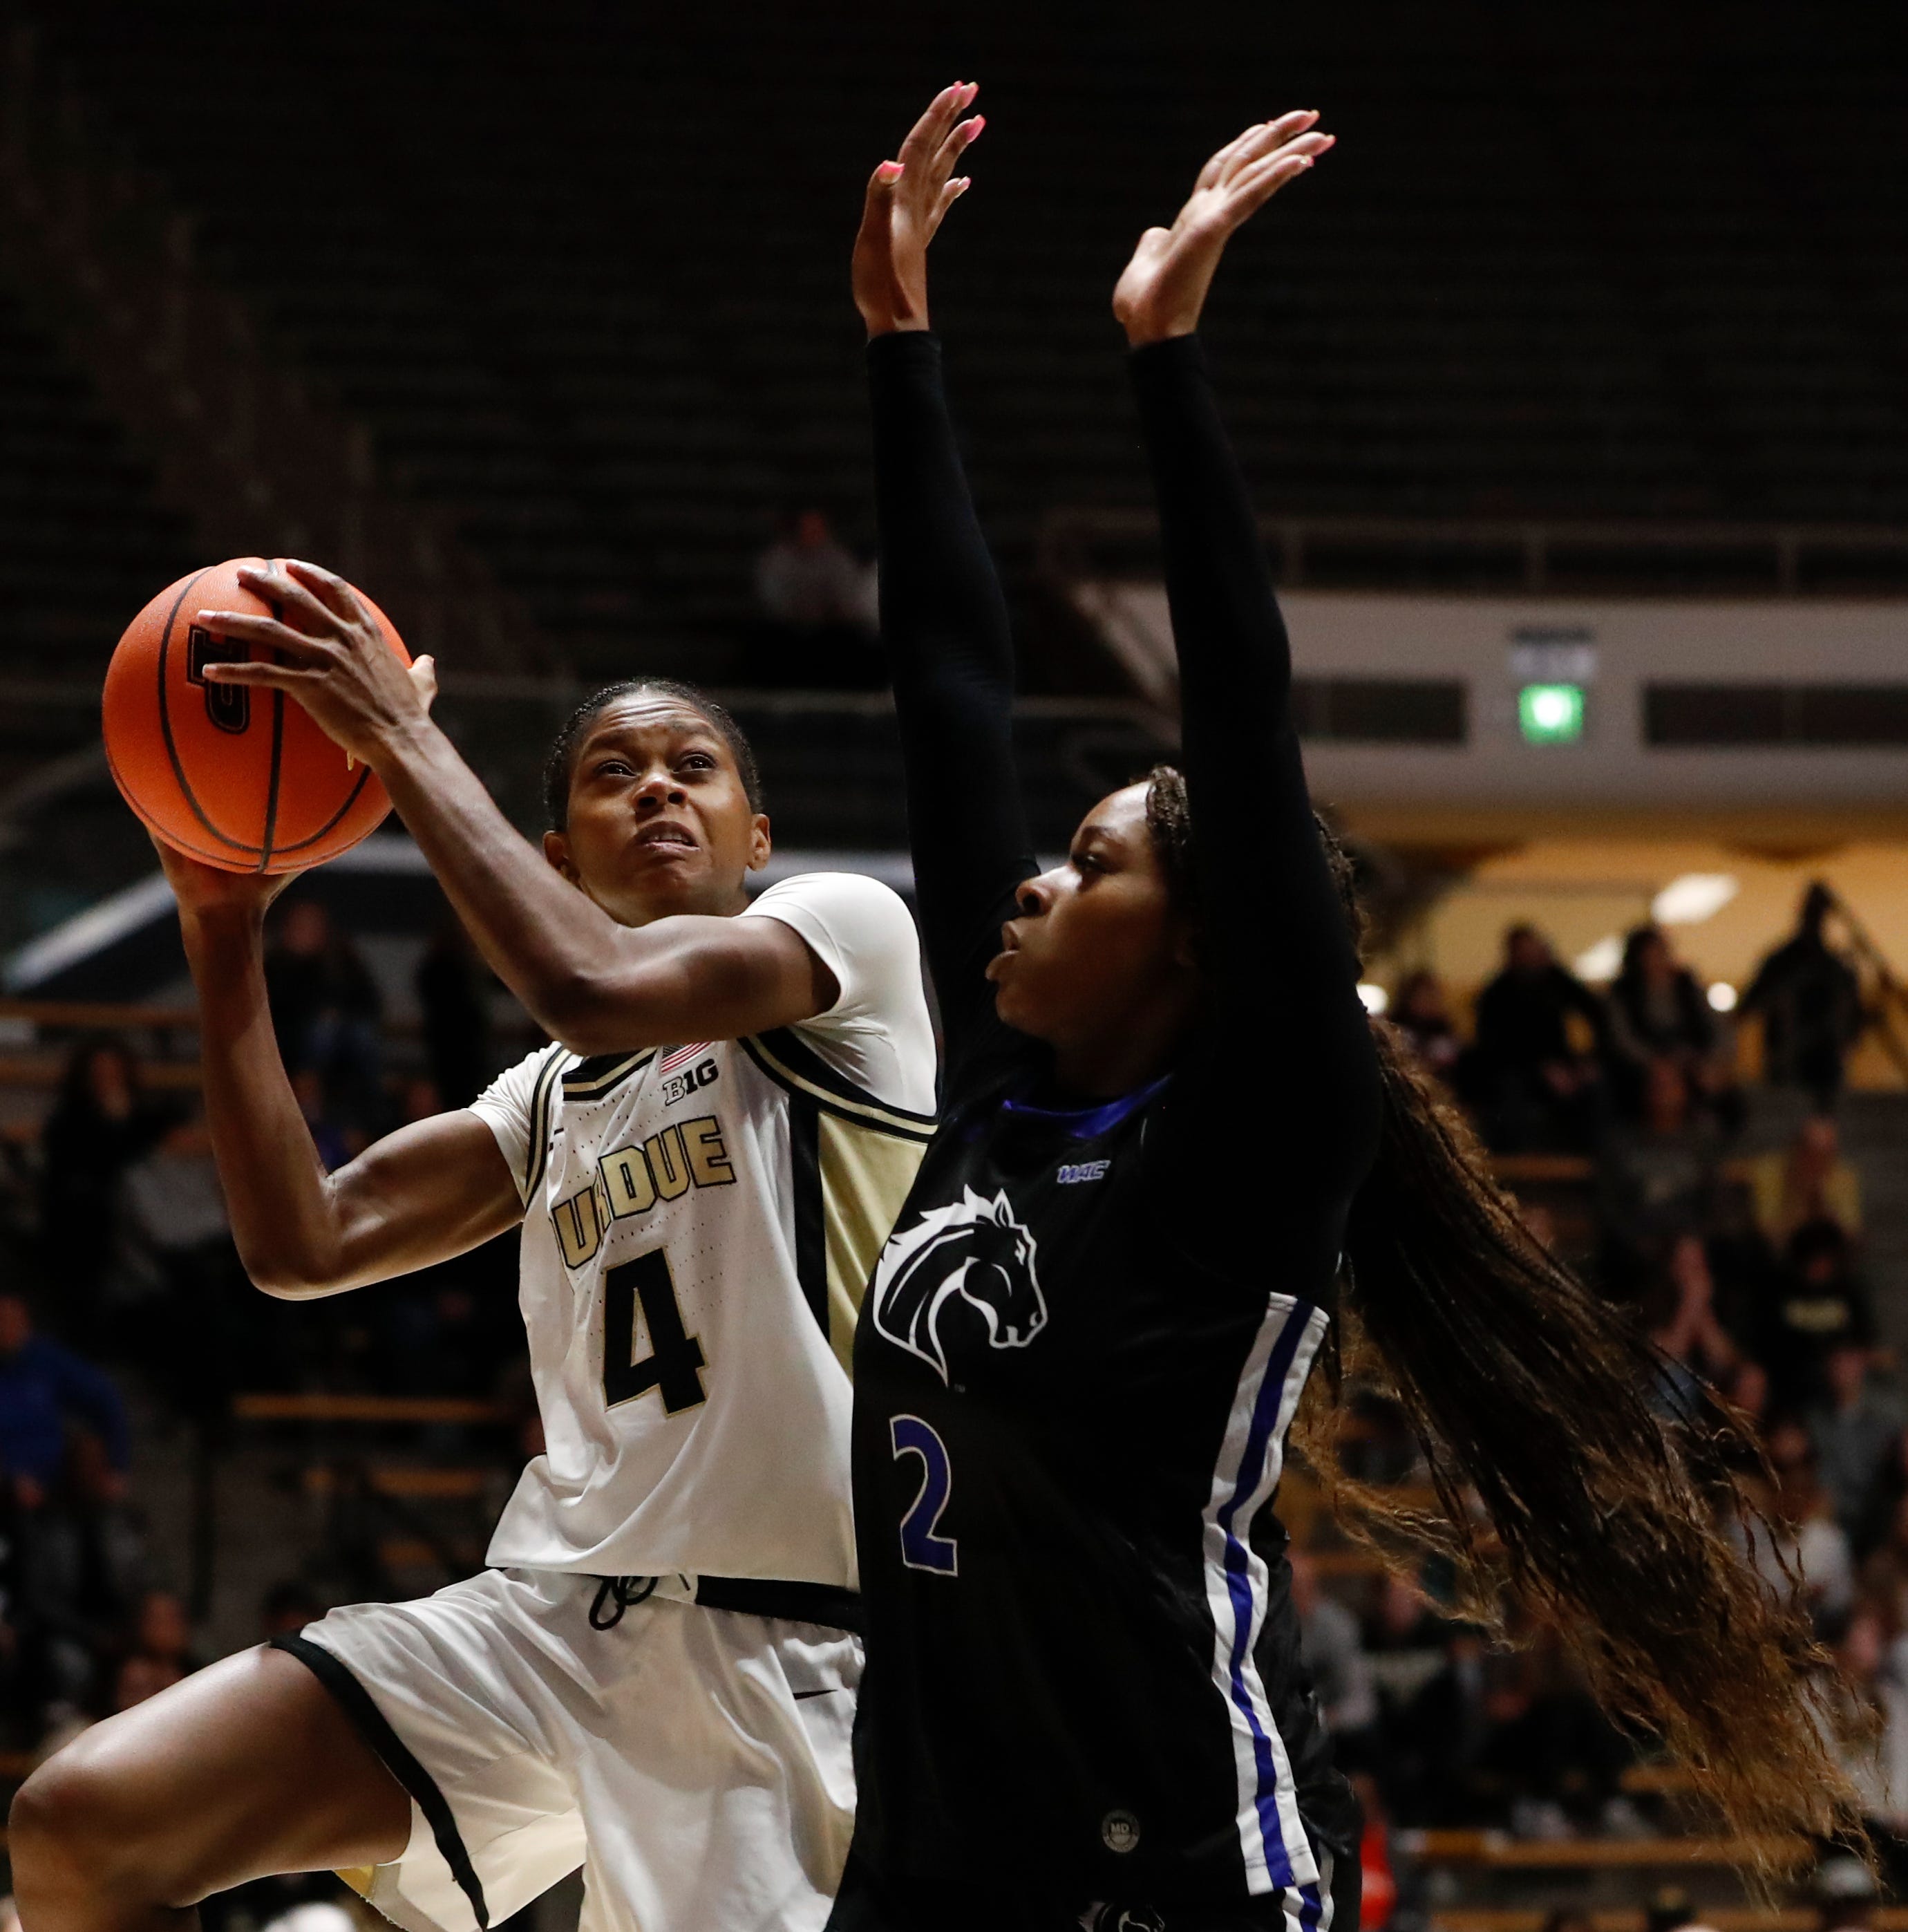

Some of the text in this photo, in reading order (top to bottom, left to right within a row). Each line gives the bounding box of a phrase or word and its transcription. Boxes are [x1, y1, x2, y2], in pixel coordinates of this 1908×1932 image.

[551, 1114, 737, 1270] UDUE
[1056, 1159, 1111, 1184] WAC
[602, 1245, 710, 1419] 4
[889, 1413, 958, 1577] 2
